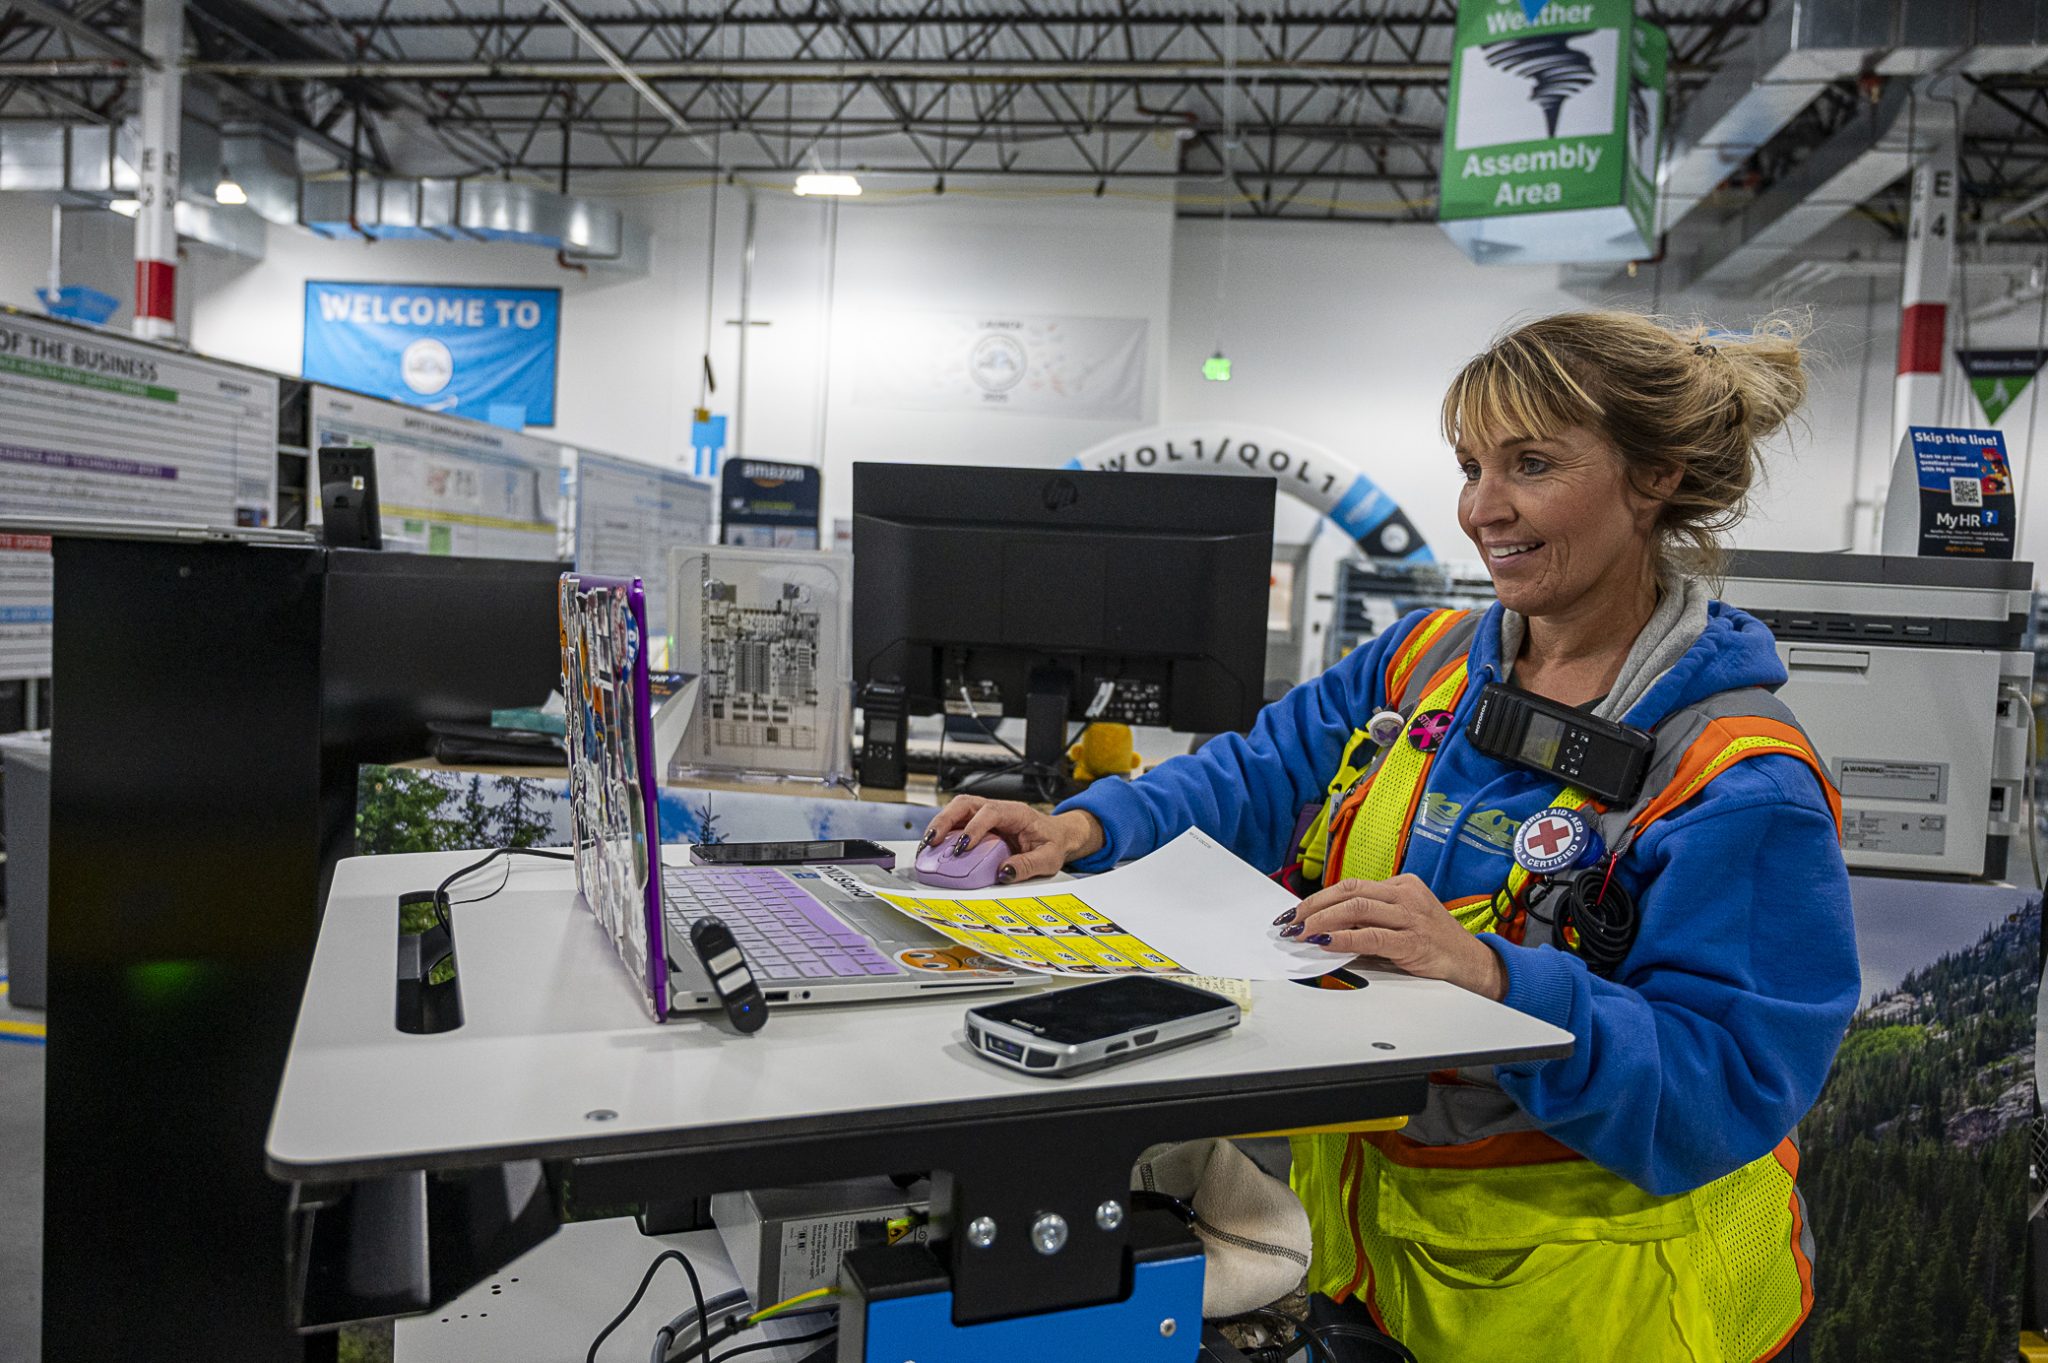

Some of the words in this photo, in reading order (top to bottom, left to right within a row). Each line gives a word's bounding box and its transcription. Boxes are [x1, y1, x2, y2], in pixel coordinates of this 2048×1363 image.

[1461, 142, 1603, 180] Assembly
[1493, 181, 1562, 207] Area
[1934, 171, 1952, 197] E
[1930, 212, 1946, 238] 4
[319, 292, 485, 327] WELCOME
[494, 301, 541, 329] TO
[29, 337, 67, 363] THE
[72, 347, 159, 383] BUSINESS
[1914, 432, 1943, 445] Skip
[1945, 433, 1967, 444] the
[1969, 434, 1998, 446] line!
[742, 462, 805, 482] amazon
[1474, 699, 1488, 736] MOTOROLA
[1849, 766, 1884, 774] WARNING
[1570, 816, 1584, 833] AED
[1527, 844, 1578, 868] CERTIFIED
